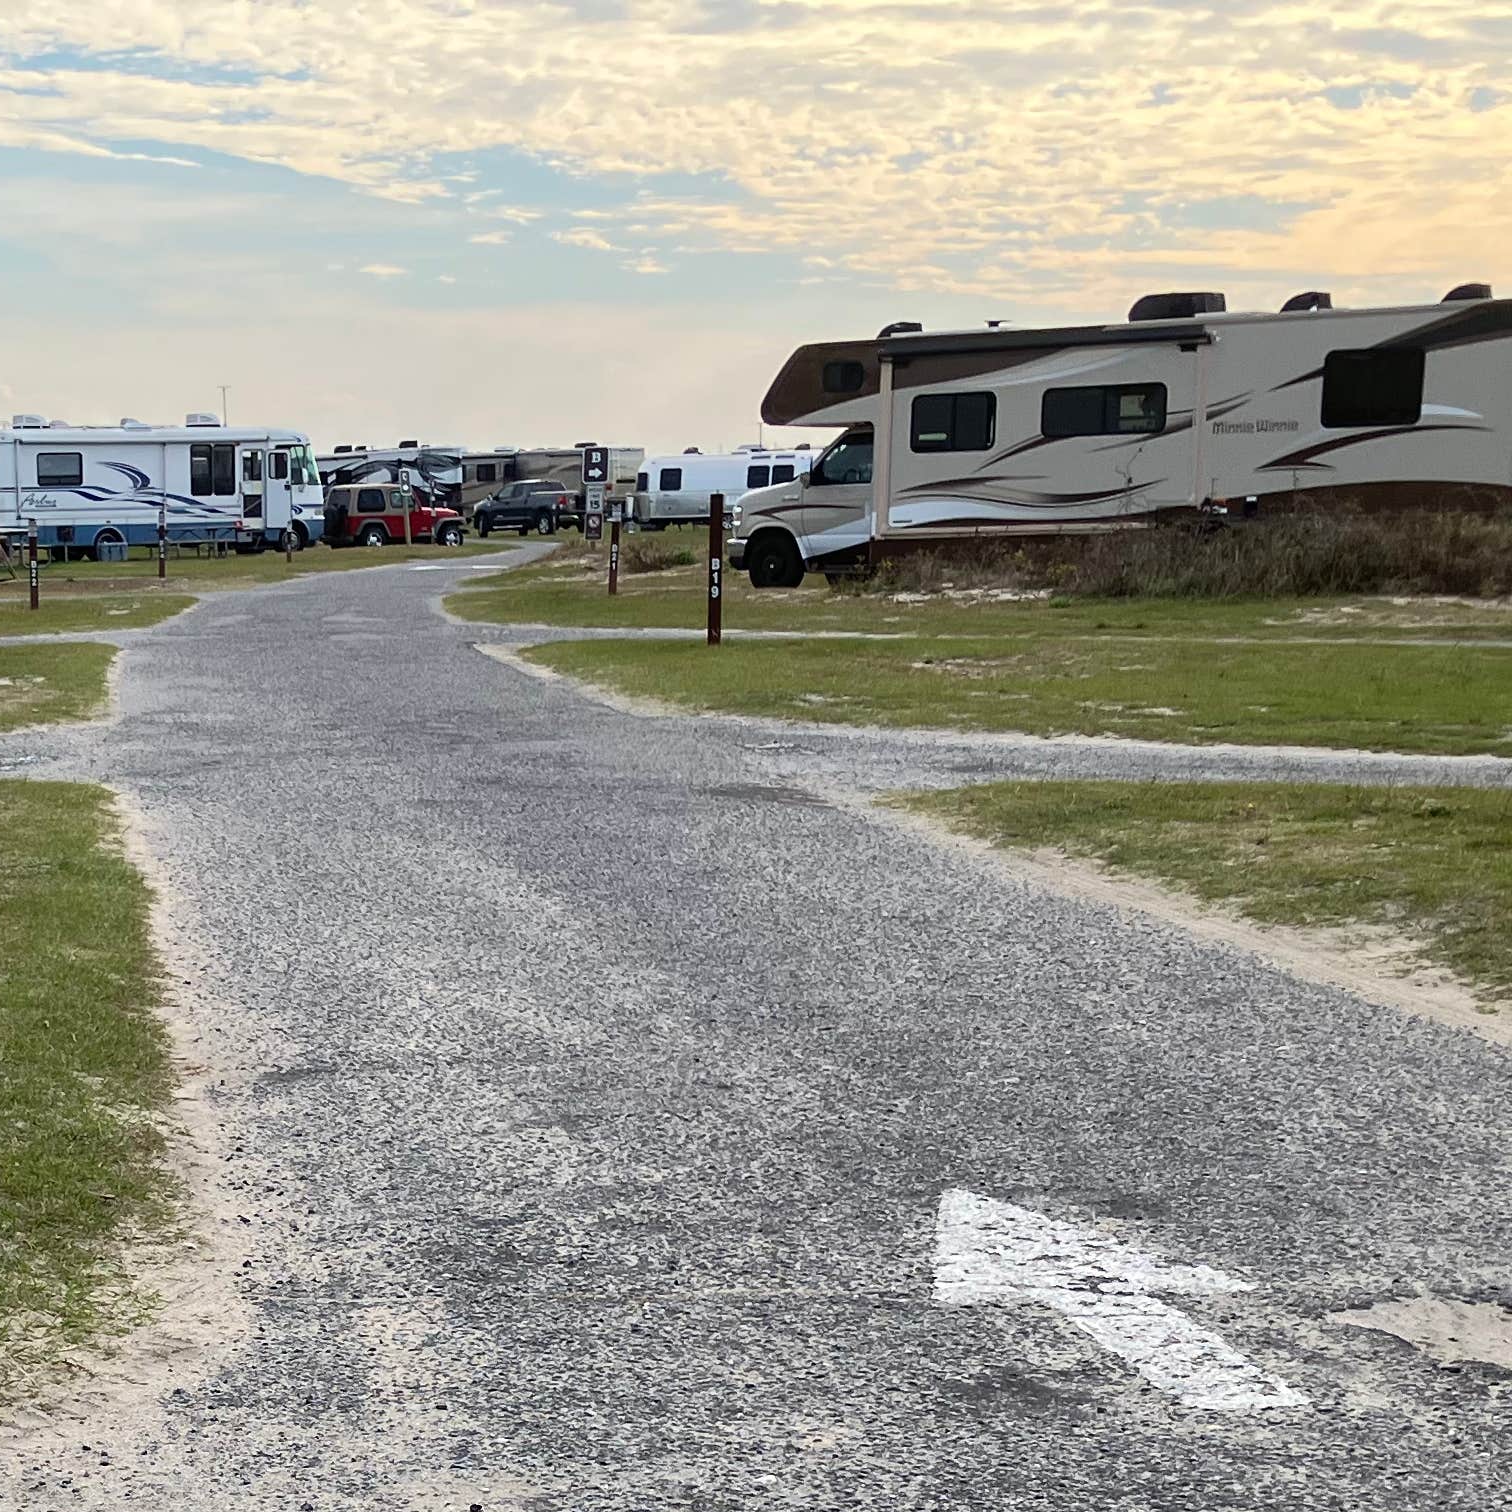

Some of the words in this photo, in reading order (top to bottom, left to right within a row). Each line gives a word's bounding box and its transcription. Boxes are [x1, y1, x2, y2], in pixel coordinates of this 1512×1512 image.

[591, 451, 601, 463] B
[590, 500, 600, 509] 15
[711, 558, 720, 598] B19
